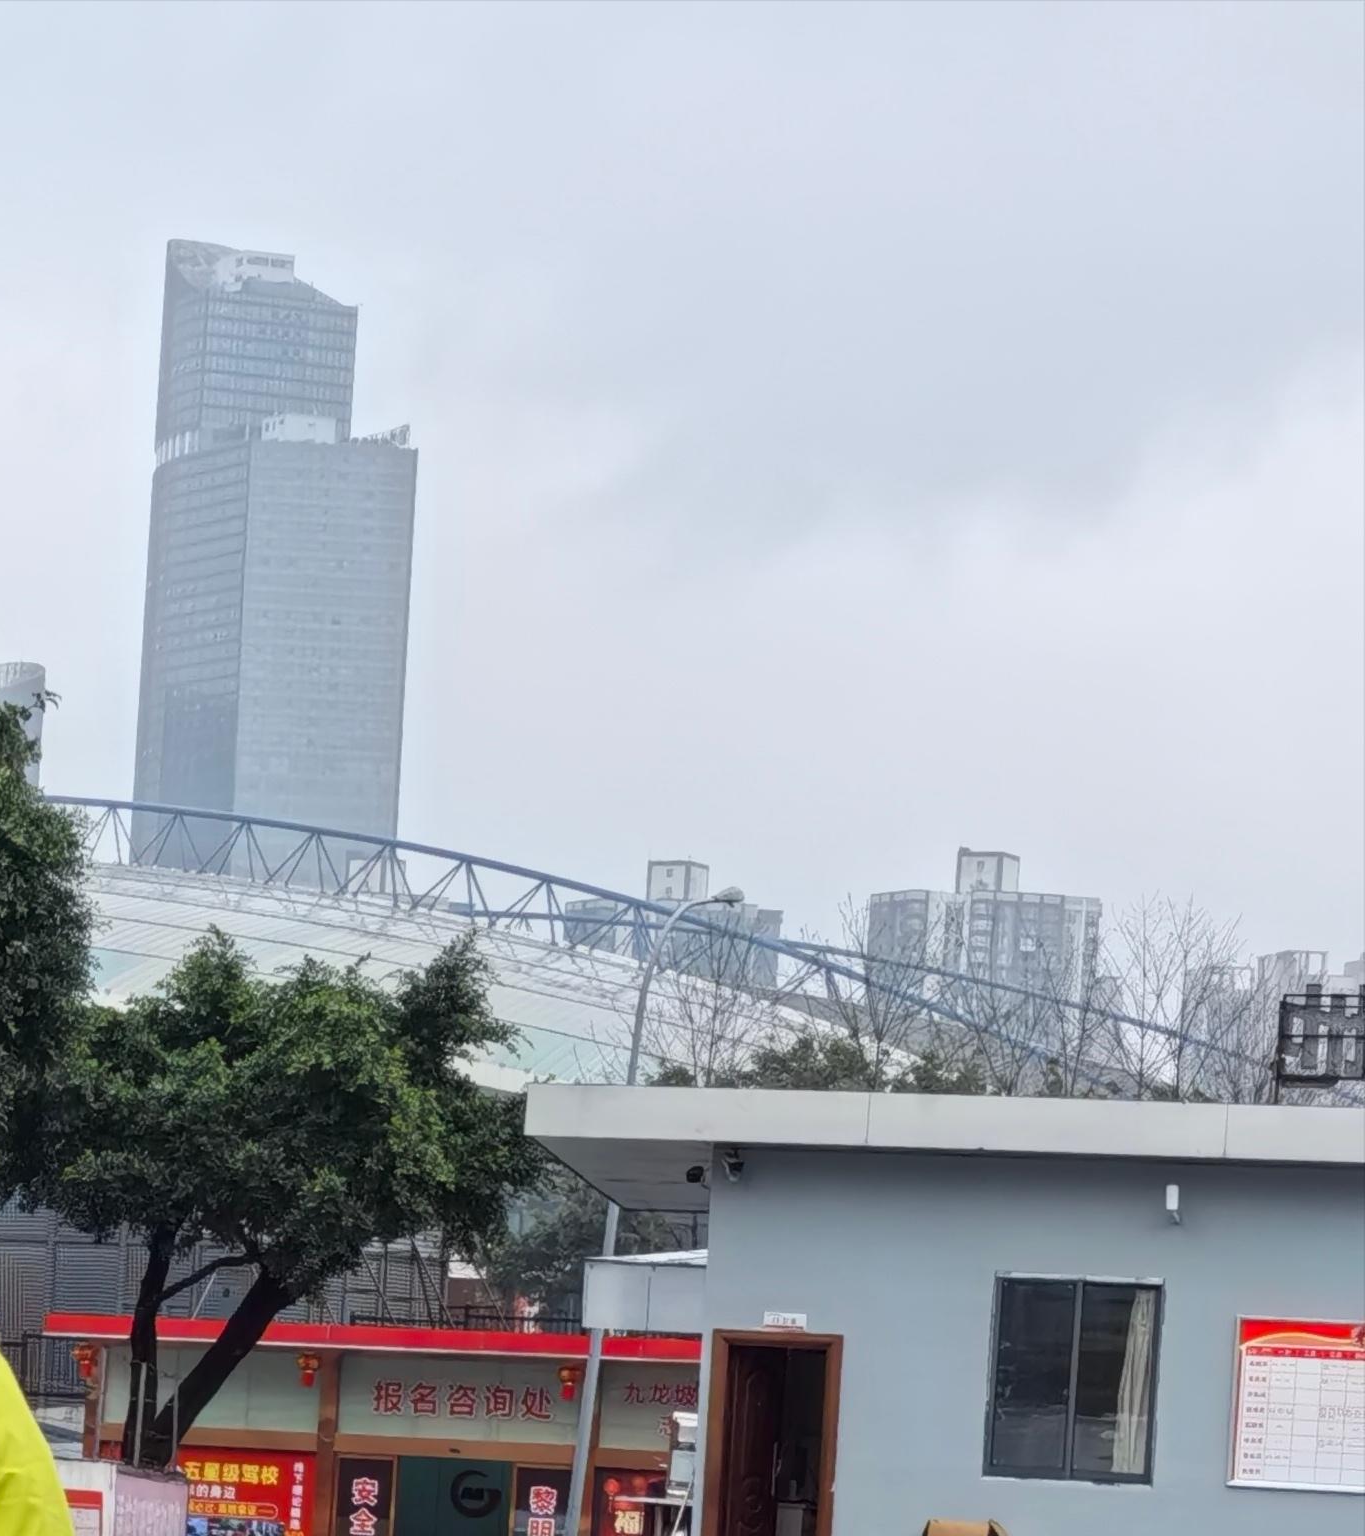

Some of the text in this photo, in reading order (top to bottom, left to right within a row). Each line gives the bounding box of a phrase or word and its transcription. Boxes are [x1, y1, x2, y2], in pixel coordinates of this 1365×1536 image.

[372, 1380, 553, 1421] 报名咨询处
